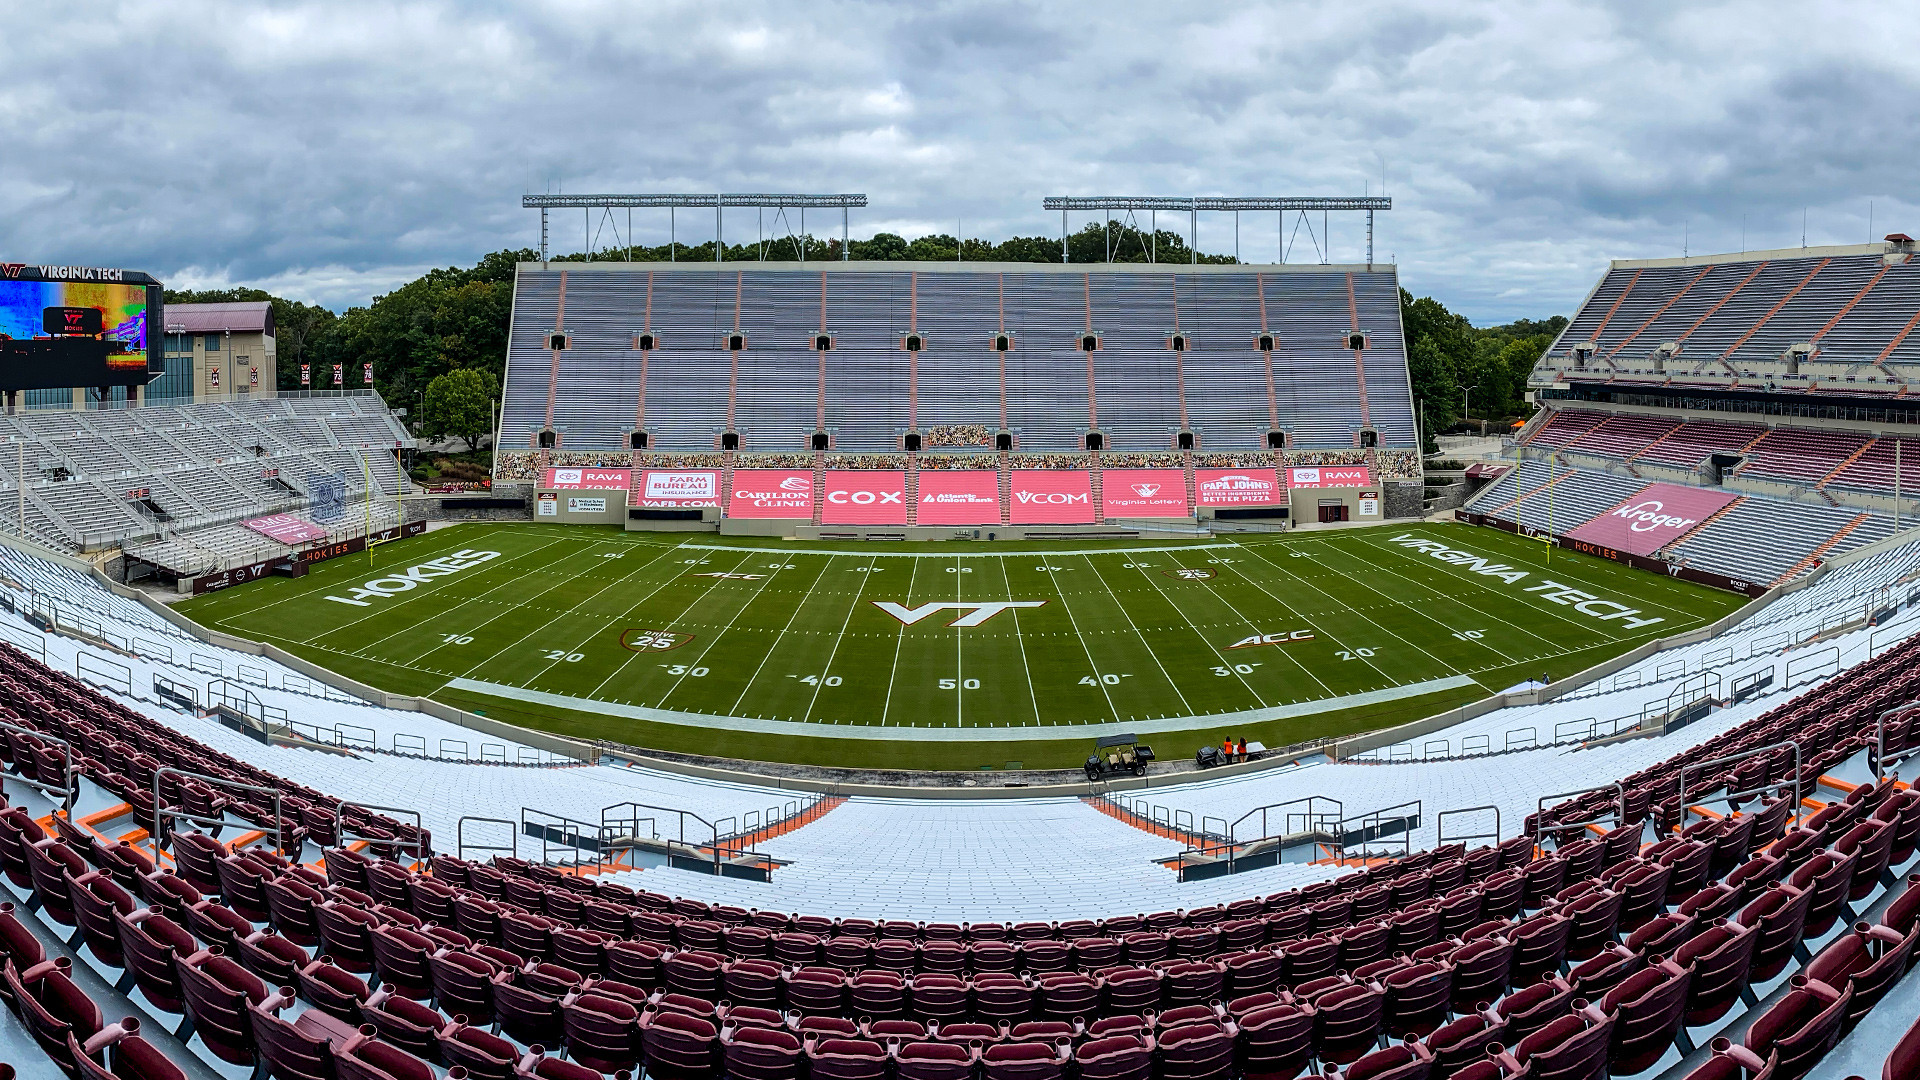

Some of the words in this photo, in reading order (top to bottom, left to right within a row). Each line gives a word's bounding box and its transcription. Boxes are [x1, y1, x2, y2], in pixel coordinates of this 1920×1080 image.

[1, 263, 26, 278] VT
[39, 265, 94, 280] VIRGINIA
[96, 267, 122, 280] TECH
[64, 313, 83, 324] VT
[586, 473, 623, 481] RAV4
[1325, 471, 1362, 479] RAV4
[1203, 482, 1231, 490] PAPA
[1232, 480, 1270, 490] JOHN'S
[735, 490, 809, 500] CARILION
[827, 490, 902, 504] COX
[1015, 489, 1088, 504] VCOM
[754, 499, 810, 507] CLINIC
[1616, 500, 1696, 533] Kroger
[381, 530, 393, 541] VT
[1524, 526, 1536, 537] VT
[306, 543, 348, 561] HOKIES
[1575, 541, 1617, 560] HOKIES
[250, 563, 266, 577] VT
[1666, 563, 1683, 577] VT
[323, 549, 502, 607] HOKIES
[1388, 533, 1531, 585] VIRGINIA
[1522, 579, 1666, 630] TECH
[869, 600, 1050, 628] VT
[443, 633, 474, 645] 10
[644, 630, 676, 638] DRIVE
[1225, 629, 1315, 650] ACC
[1452, 630, 1485, 642] 10
[630, 635, 676, 649] 25
[544, 650, 585, 663] 20
[1335, 648, 1376, 661] 20
[667, 664, 710, 677] 30
[1209, 664, 1254, 677] 30
[799, 675, 843, 687] 40
[938, 678, 981, 690] 50
[1078, 674, 1120, 687] 40
